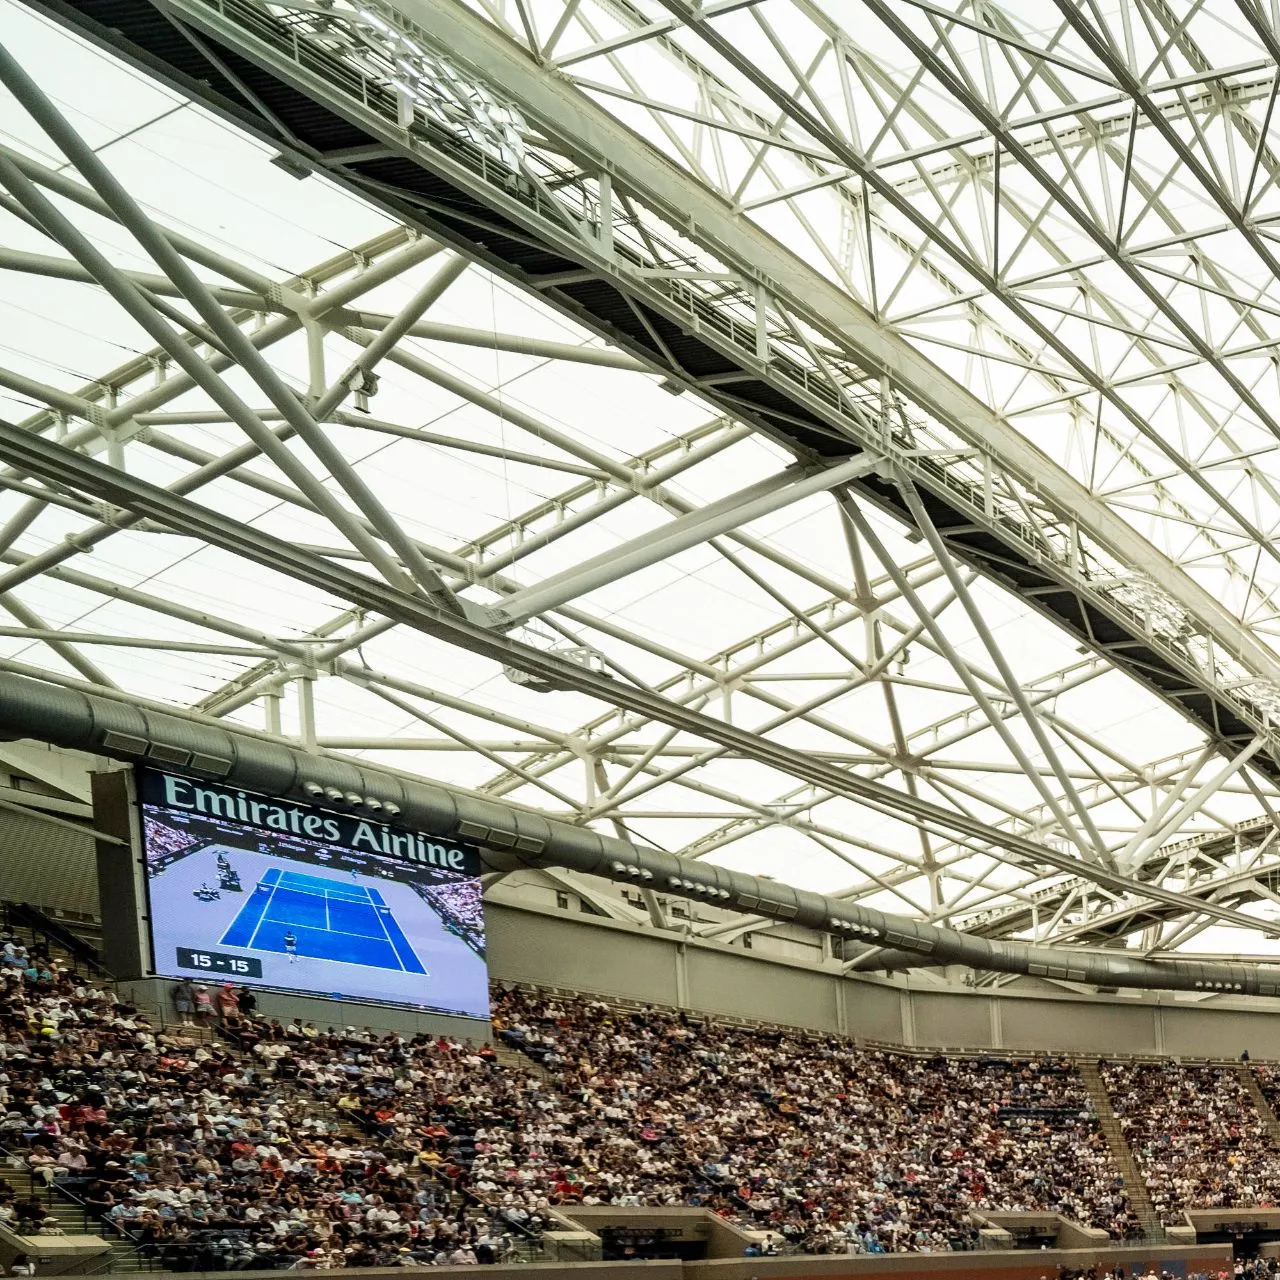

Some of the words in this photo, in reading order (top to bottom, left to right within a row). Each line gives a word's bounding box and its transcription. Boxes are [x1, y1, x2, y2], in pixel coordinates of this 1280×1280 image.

[163, 774, 341, 841] Emirates
[352, 822, 465, 870] Airline
[191, 954, 212, 967] 15
[229, 960, 249, 972] 15
